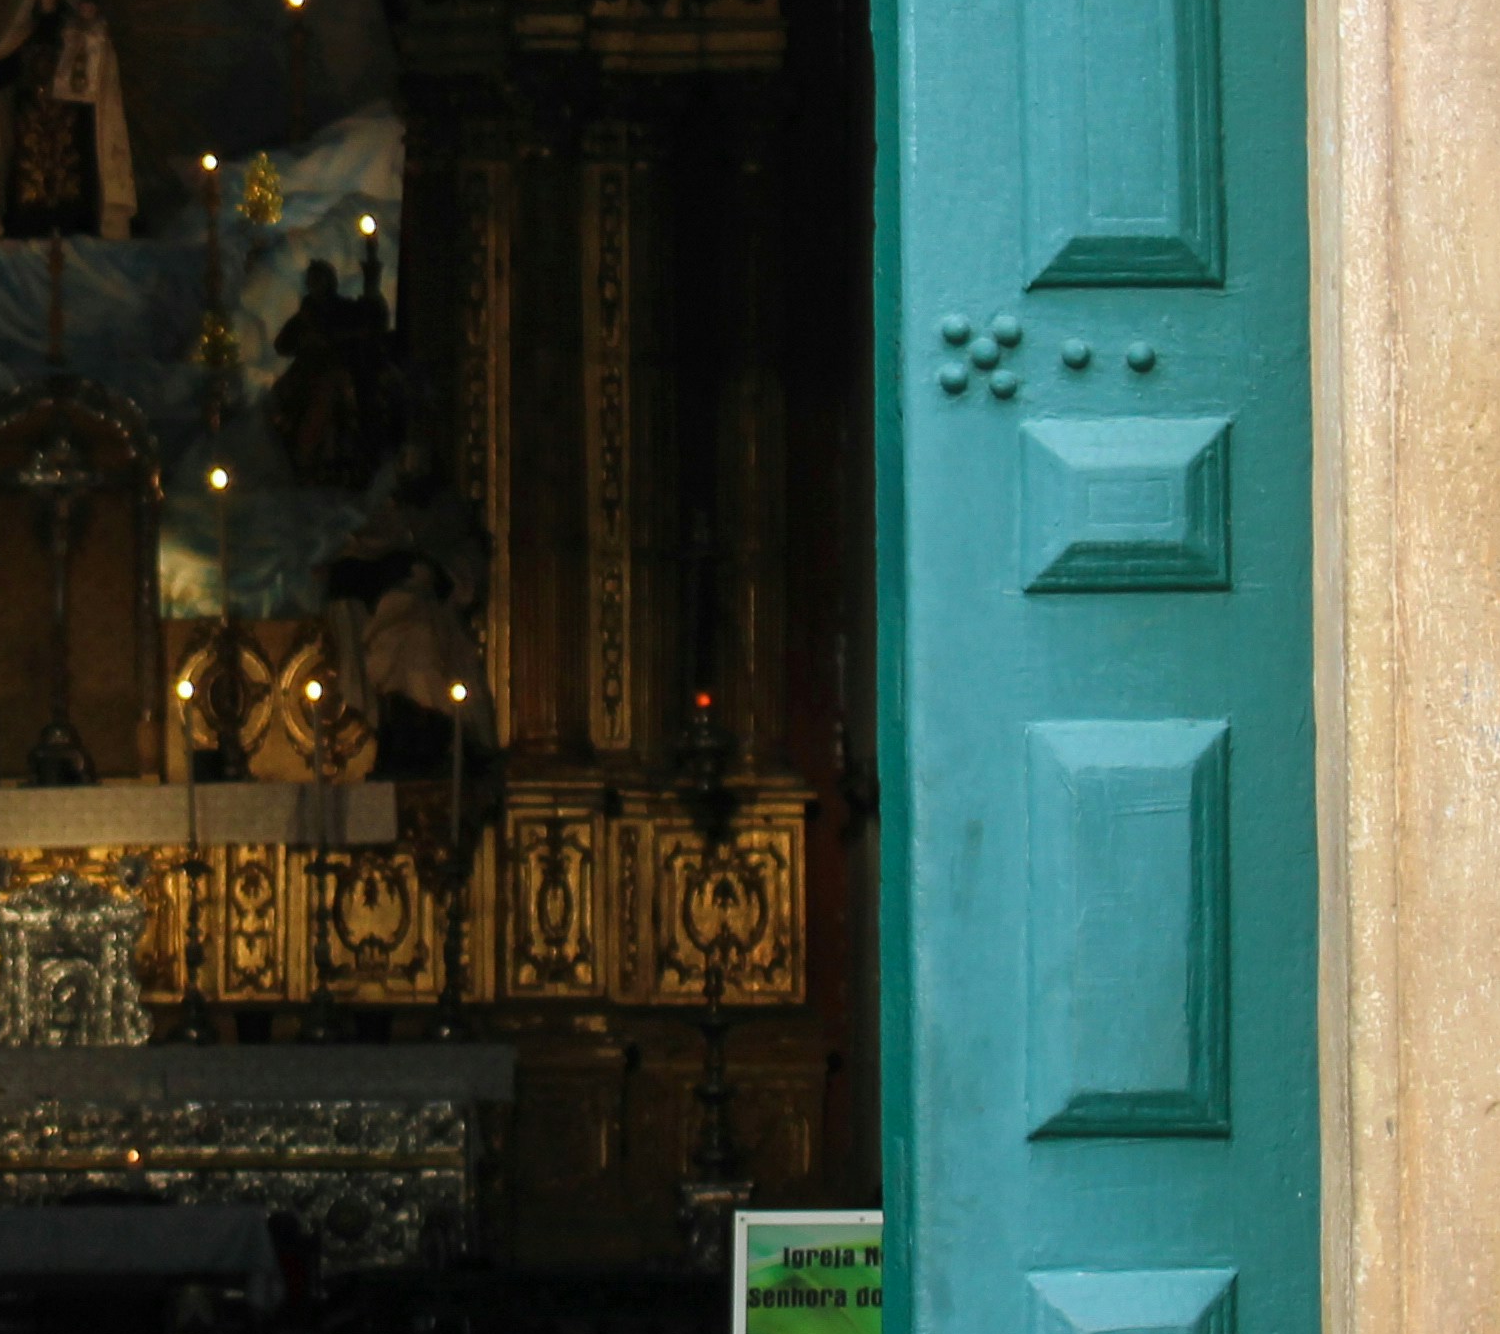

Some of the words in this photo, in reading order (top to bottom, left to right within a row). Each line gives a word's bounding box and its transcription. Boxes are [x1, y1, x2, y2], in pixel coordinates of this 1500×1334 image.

[783, 1245, 856, 1270] Igreja
[864, 1245, 883, 1267] N
[747, 1287, 847, 1308] Senhora
